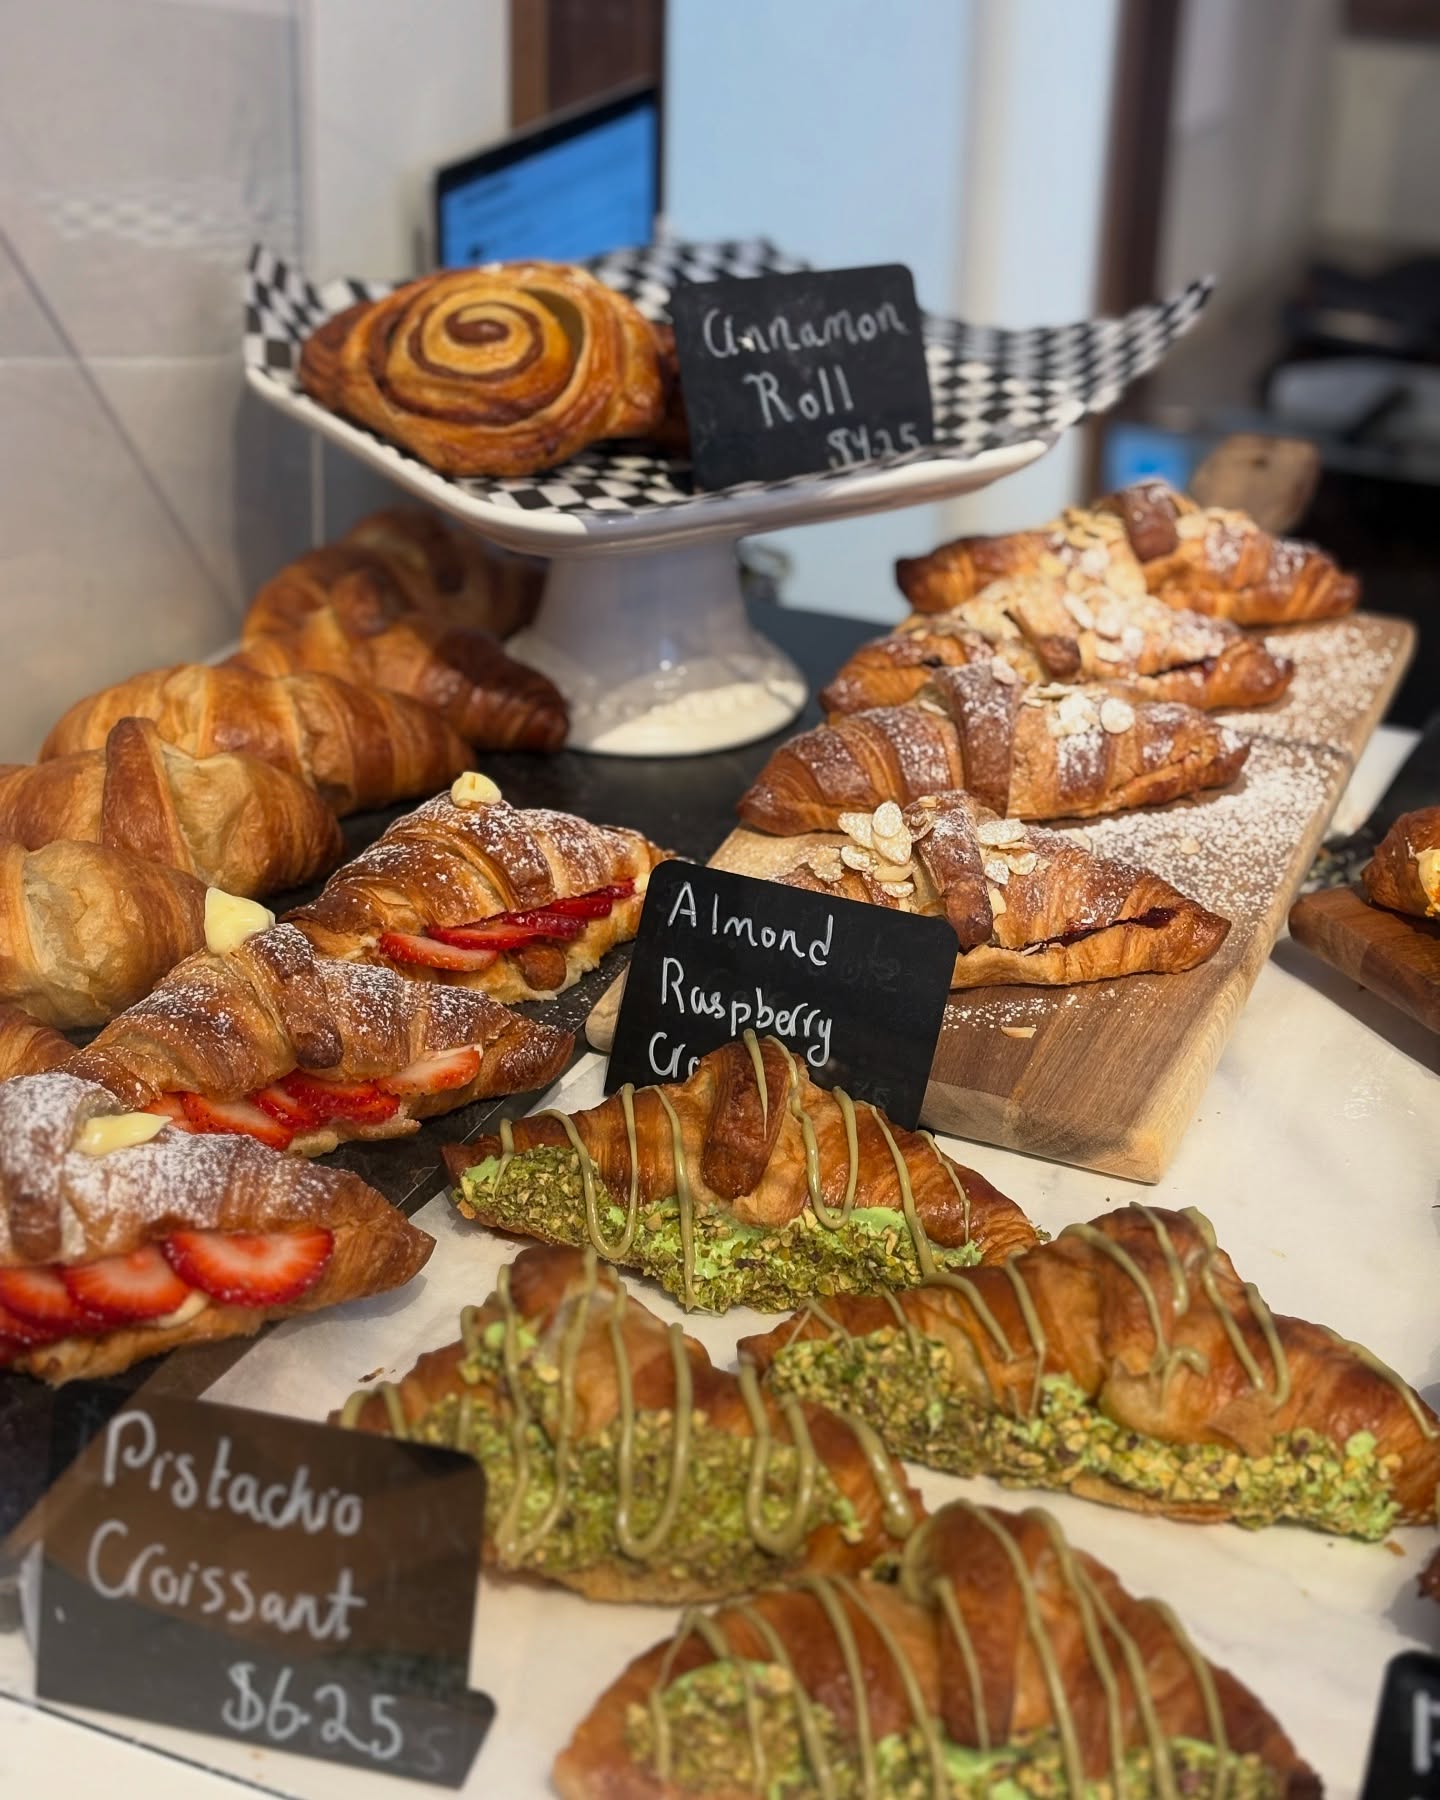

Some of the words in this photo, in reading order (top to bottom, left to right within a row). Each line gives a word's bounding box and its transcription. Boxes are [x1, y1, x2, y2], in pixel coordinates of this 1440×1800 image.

[703, 302, 911, 359] Cinnamon
[742, 365, 854, 428] Roll
[667, 881, 834, 966] Almond
[661, 956, 833, 1068] Raspberry
[103, 1409, 363, 1536] Pistachio
[87, 1519, 367, 1641] Croissant
[221, 1661, 404, 1760] $6.25
